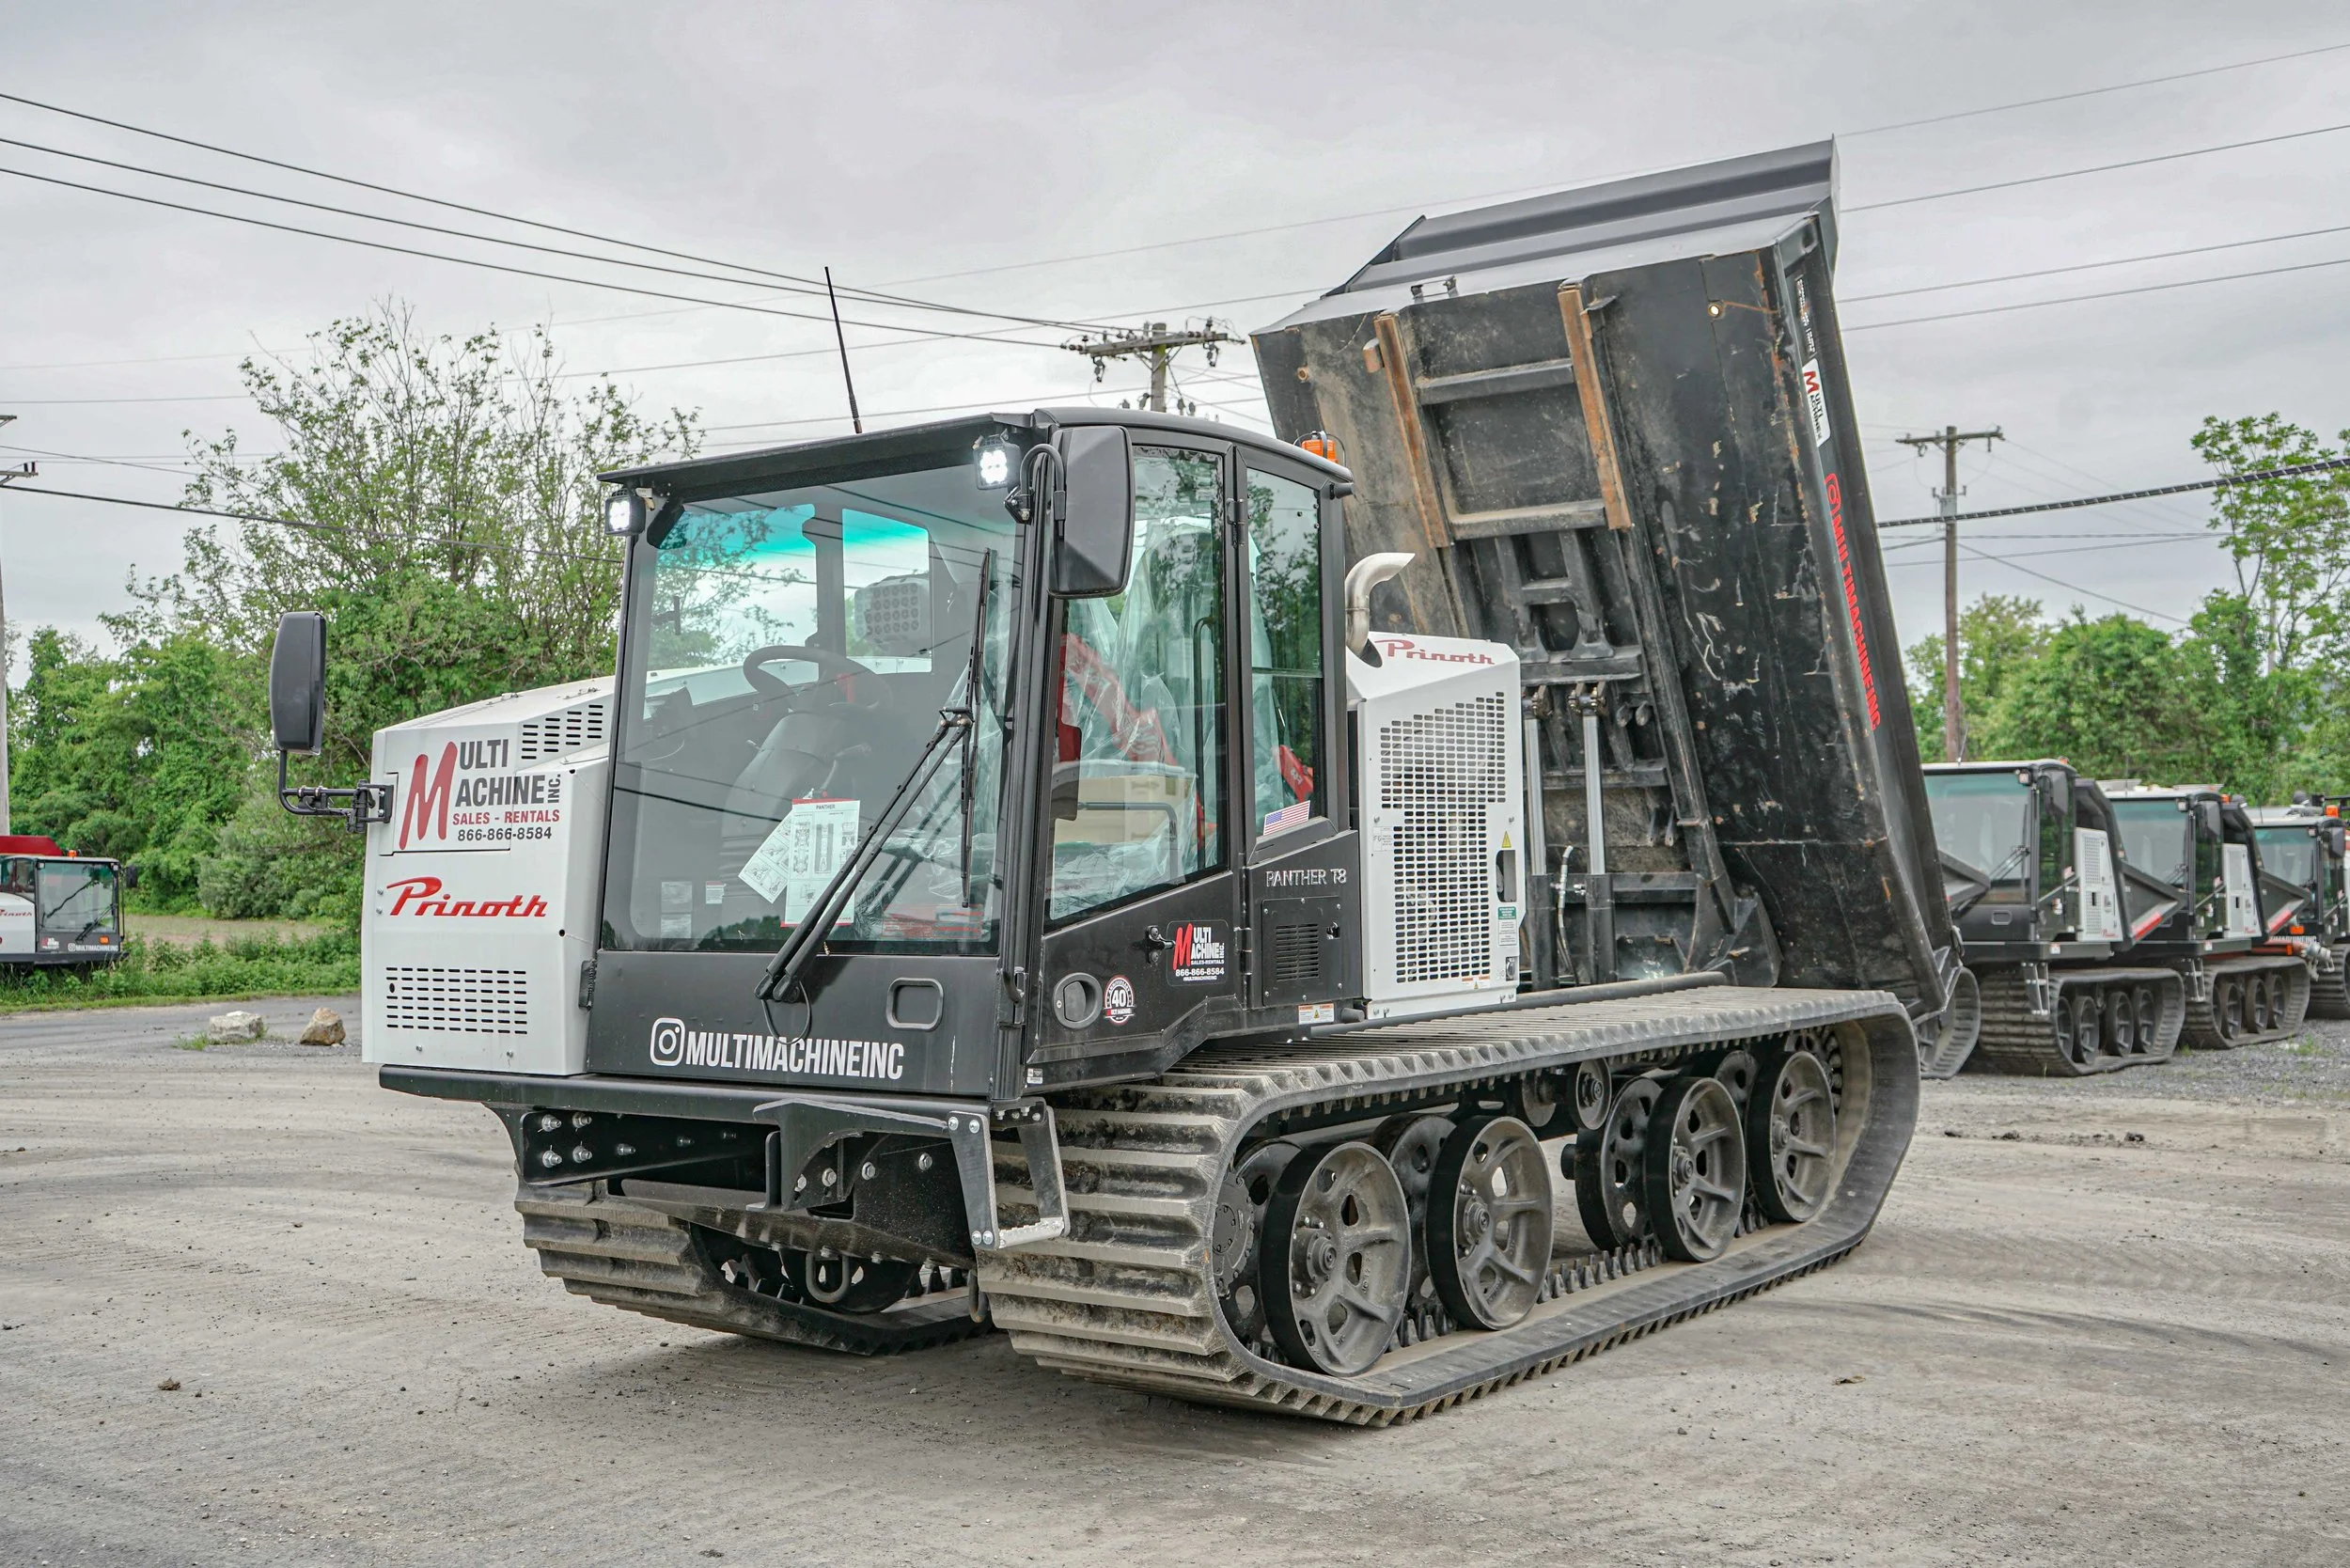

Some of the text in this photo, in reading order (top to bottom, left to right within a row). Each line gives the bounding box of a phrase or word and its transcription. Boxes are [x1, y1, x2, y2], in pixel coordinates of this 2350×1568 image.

[1374, 639, 1496, 665] Prinoth
[547, 774, 561, 804] INC.
[452, 811, 491, 825] SALES
[504, 809, 559, 823] RENTALS
[457, 826, 552, 841] 866-866-8584
[1265, 869, 1347, 887] PANTHER T8
[386, 876, 548, 917] Prinoth
[1175, 967, 1225, 977] 866-866-8584
[1111, 989, 1127, 1008] 40
[685, 1030, 904, 1079] MULTIMACHINEINC
